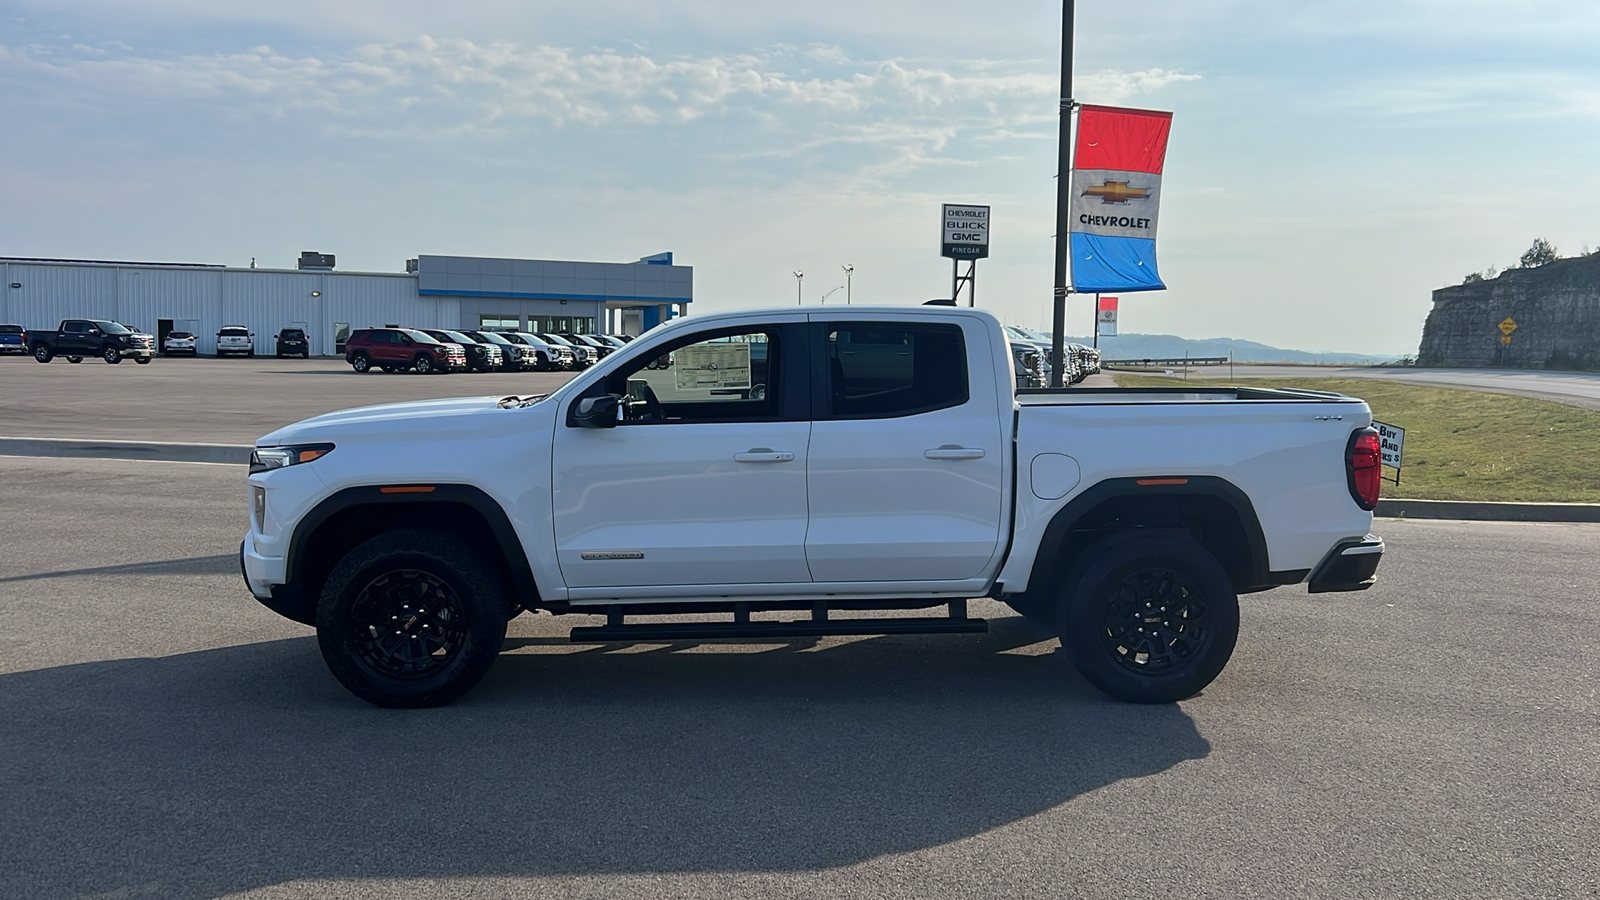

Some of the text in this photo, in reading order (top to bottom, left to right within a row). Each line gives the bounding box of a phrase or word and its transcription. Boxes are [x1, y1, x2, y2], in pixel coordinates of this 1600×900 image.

[947, 210, 986, 218] CHEVROLET
[946, 221, 986, 230] BUICK
[1080, 214, 1150, 229] CHEVROLET
[952, 233, 981, 241] GMC
